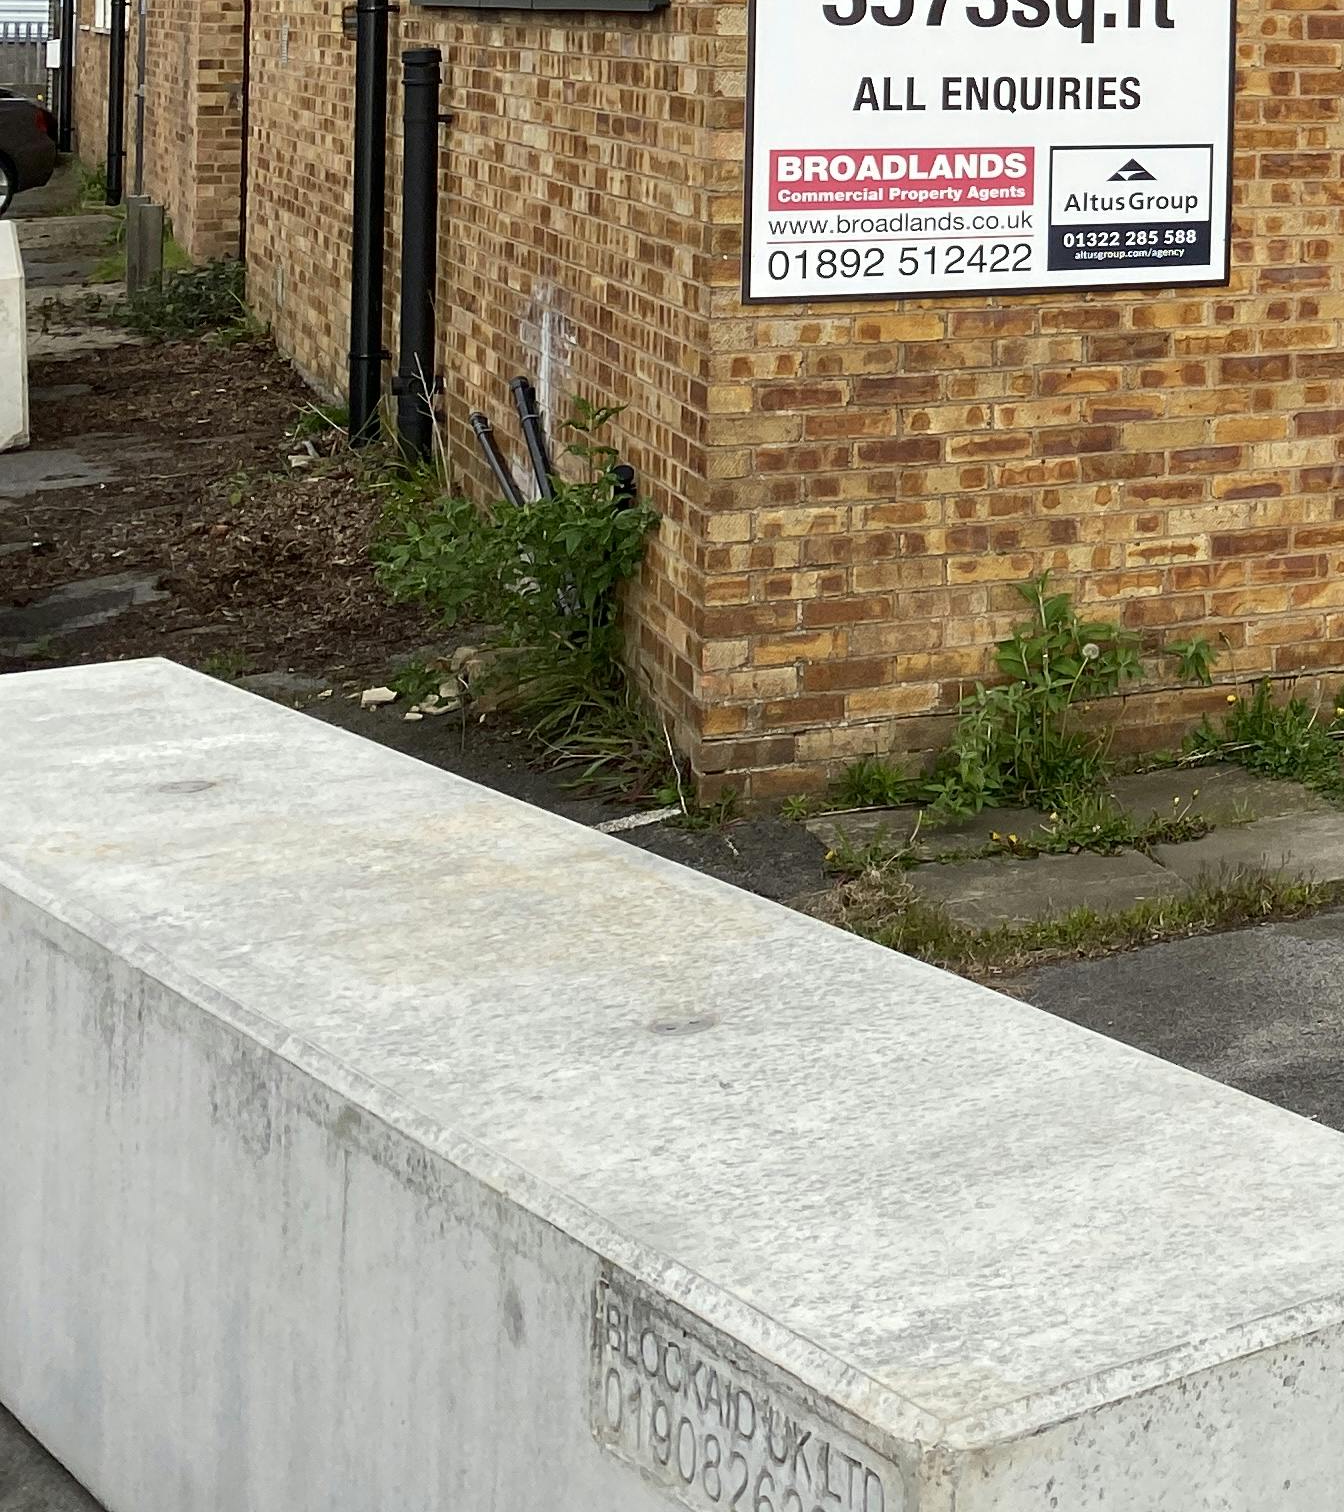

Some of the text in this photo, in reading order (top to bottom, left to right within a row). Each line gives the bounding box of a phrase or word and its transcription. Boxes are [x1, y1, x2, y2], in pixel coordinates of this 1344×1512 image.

[853, 77, 1140, 113] ALL ENQUIRIES
[778, 153, 1027, 181] BROADLANDS
[777, 184, 1026, 204] Commercial Property Agents
[768, 212, 1034, 236] www.broadlands.co.uk
[1063, 229, 1197, 248] 01322 285 588
[768, 243, 1032, 281] 01892 512422
[1074, 248, 1185, 260] altusgroup.com/agency
